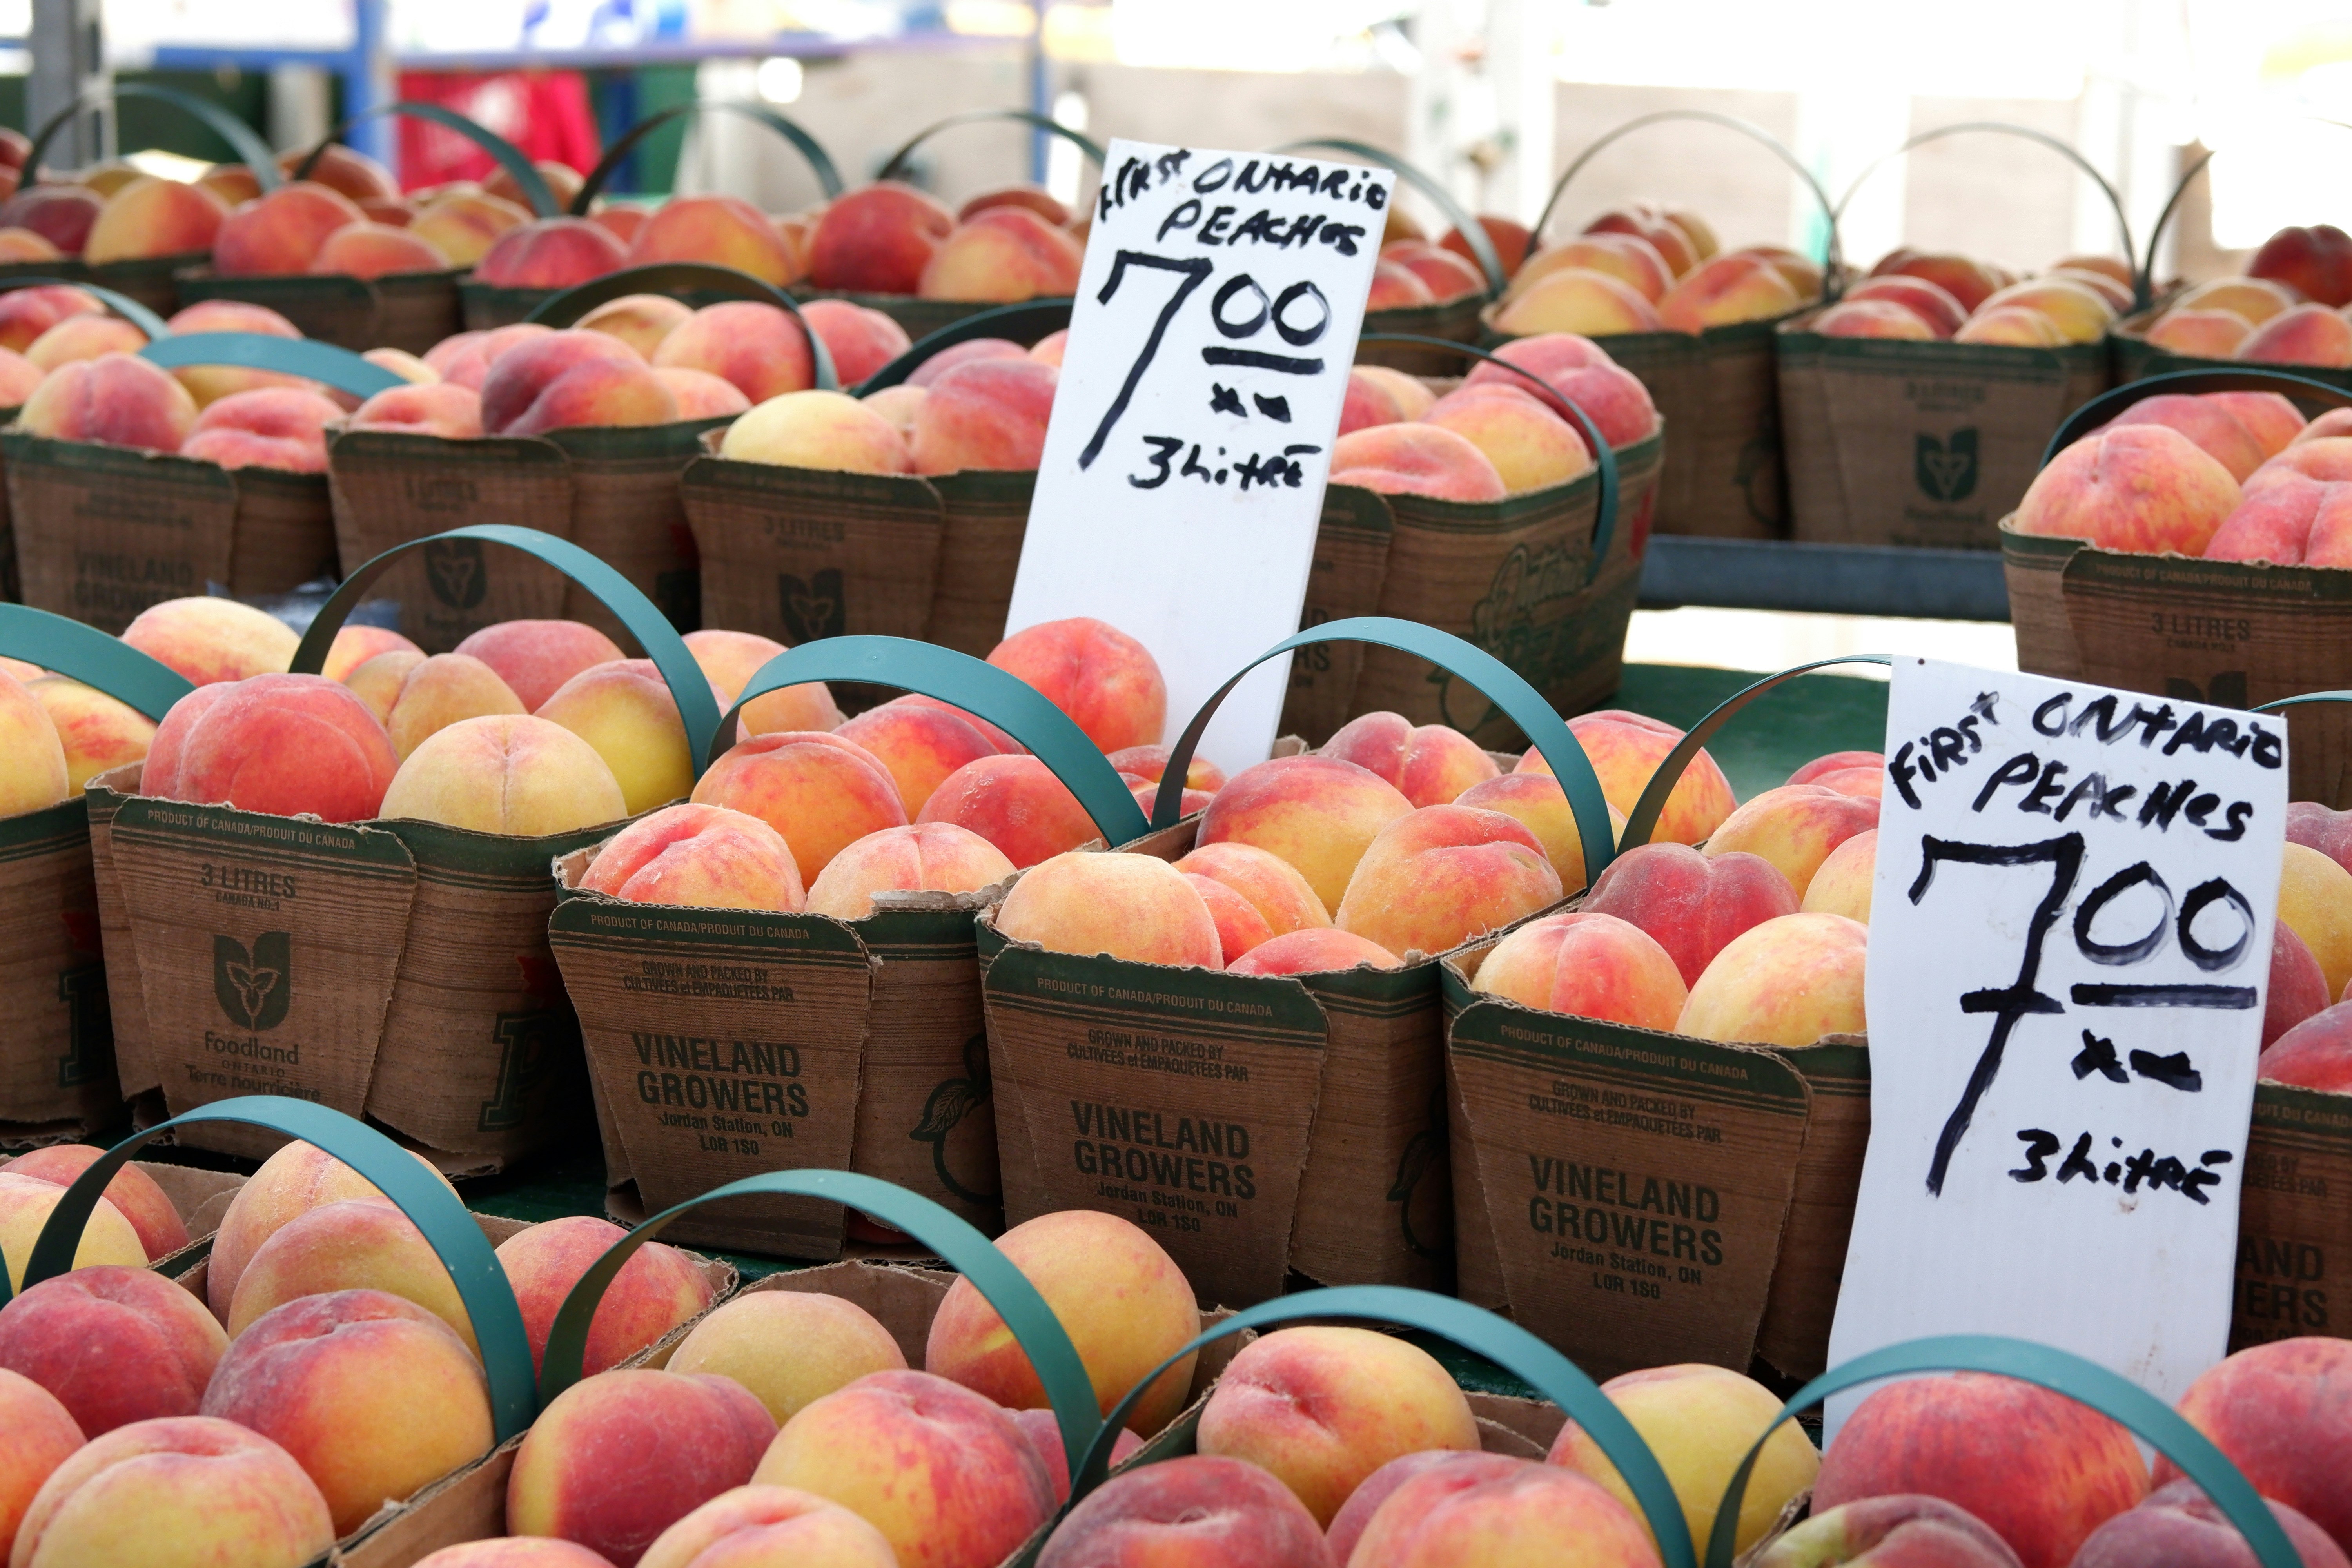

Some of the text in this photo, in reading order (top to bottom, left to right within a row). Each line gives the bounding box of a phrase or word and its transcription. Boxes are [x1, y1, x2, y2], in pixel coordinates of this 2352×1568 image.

[2096, 563, 2140, 579] PRODUCT
[2143, 568, 2157, 580] OF
[2252, 577, 2267, 588] DU
[2270, 579, 2312, 592] CANADA
[2151, 612, 2250, 641] 3 LITRES
[148, 809, 193, 827] PRODUCT
[197, 815, 209, 828] OF
[299, 832, 312, 844] DU
[316, 834, 356, 850] CANADA
[201, 863, 295, 898] 3 LITRES
[216, 890, 254, 907] CANADA
[591, 914, 637, 929] PRODUCT
[640, 919, 653, 929] OF
[749, 926, 764, 937] DU
[767, 927, 809, 940] CANADA
[642, 960, 768, 982] GROWN AND PACKED BY
[771, 985, 793, 1001] PAR
[1037, 977, 1086, 995] PRODUCT
[1091, 985, 1105, 997] OF
[1209, 1000, 1224, 1012] DU
[1227, 1002, 1272, 1017] CANADA
[205, 1031, 299, 1065] Foodland
[631, 1031, 801, 1077] VINELAND
[1088, 1029, 1224, 1060] GROWN AND PACKED BY
[1501, 1024, 1553, 1046] PRODUCT
[1557, 1036, 1572, 1049] OF
[1680, 1058, 1696, 1072] DU
[1700, 1061, 1748, 1080] CANADA
[184, 1063, 226, 1086] Terre
[221, 1060, 285, 1077] ONTARIO
[1225, 1065, 1249, 1082] PAR
[637, 1070, 809, 1117] GROWERS
[1552, 1080, 1695, 1119] GROWN AND PACKED BY
[660, 1111, 794, 1138] Jordan Station, ON
[1071, 1100, 1250, 1159] VINELAND
[2282, 1106, 2301, 1121] DU
[1696, 1124, 1721, 1143] PAR
[1074, 1140, 1256, 1199] GROWERS
[1098, 1181, 1238, 1218] Jordan Station, ON
[1530, 1155, 1719, 1223] VINELAND
[1530, 1196, 1722, 1265] GROWERS
[1551, 1242, 1702, 1285] Jordan Station, ON
